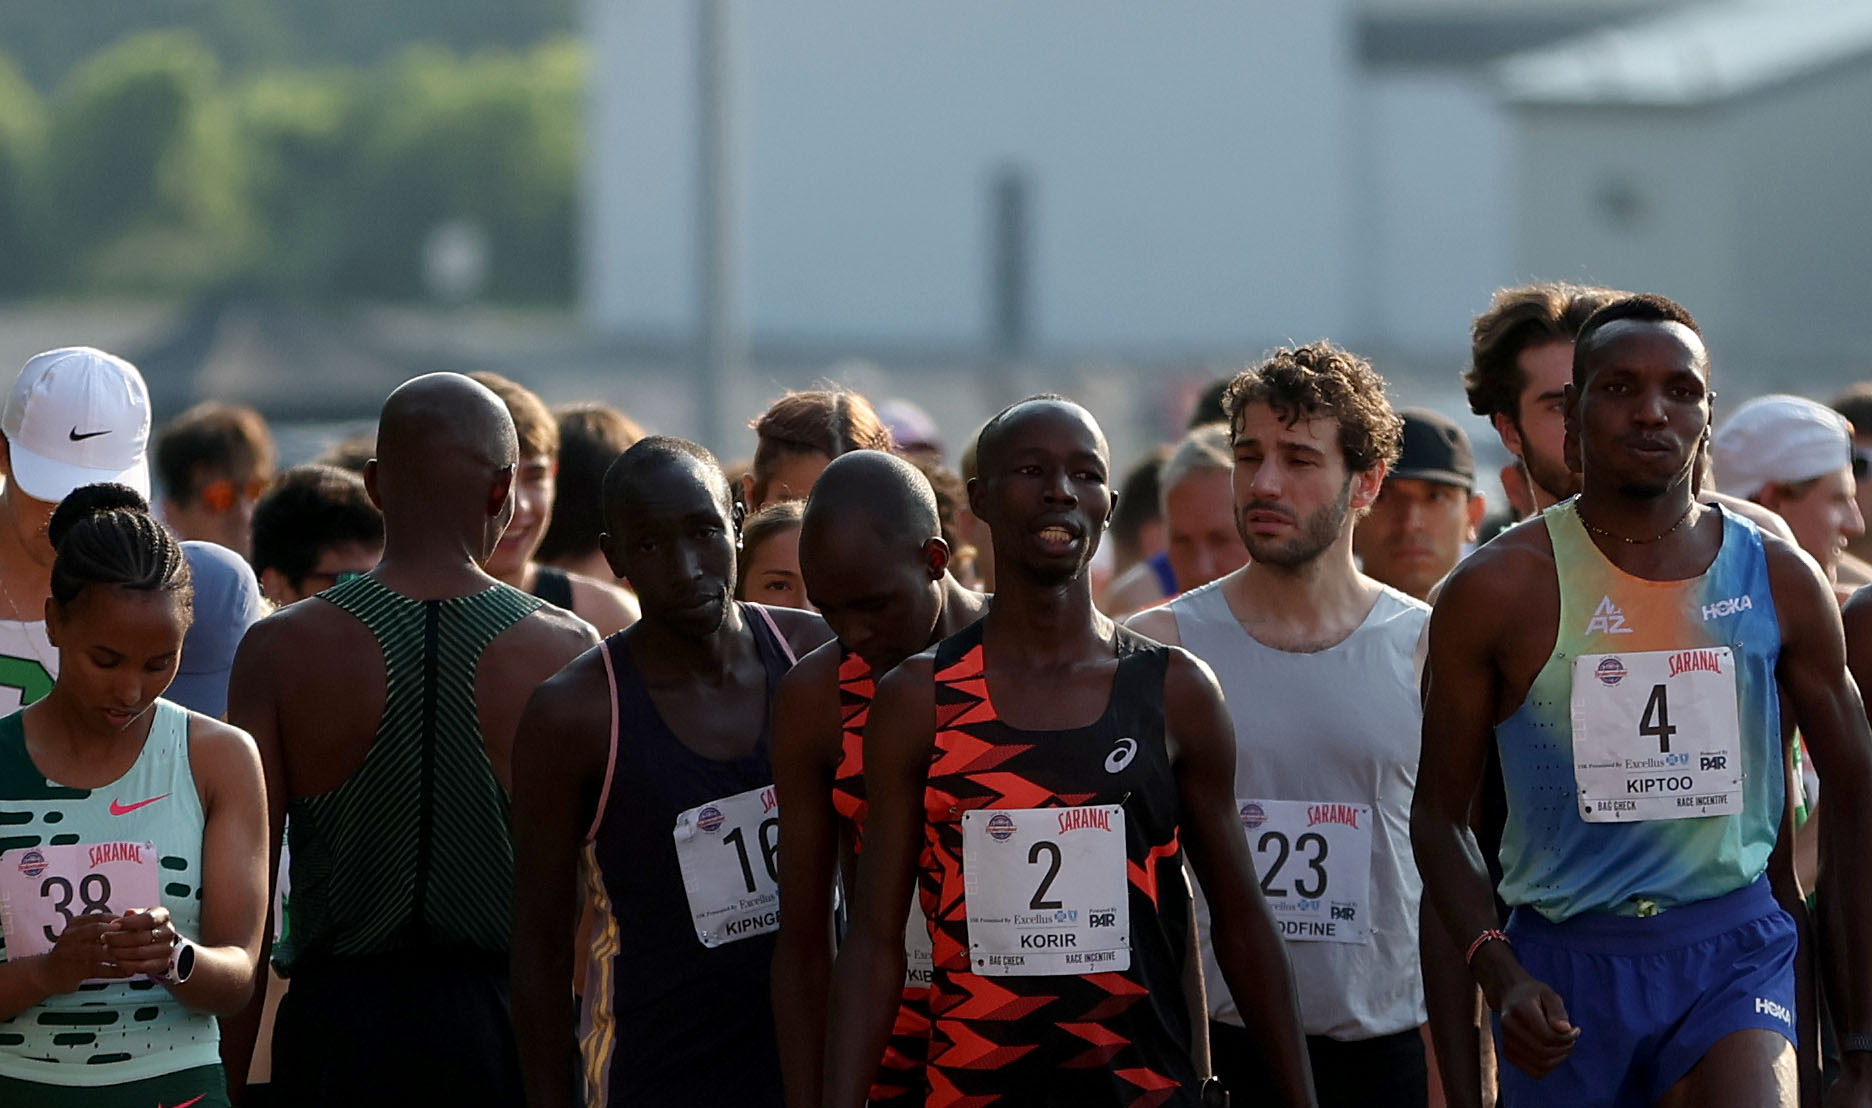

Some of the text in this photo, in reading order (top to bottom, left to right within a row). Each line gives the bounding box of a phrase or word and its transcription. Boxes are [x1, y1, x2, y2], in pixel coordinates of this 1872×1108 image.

[1702, 595, 1752, 621] HOKA
[1668, 650, 1722, 678] SARANAC
[1639, 684, 1677, 753] 4
[1625, 757, 1665, 770] Excellus
[1700, 756, 1727, 771] PAR
[1627, 776, 1693, 793] KIPTOO
[1598, 800, 1636, 811] BAG CHECK
[1058, 808, 1111, 835] SARANAC
[1307, 804, 1359, 830] SARANAC
[89, 843, 142, 869] SARANAC
[723, 817, 779, 893] 16
[1258, 831, 1328, 899] 23
[1028, 840, 1063, 910] 2
[40, 873, 113, 943] 38
[1331, 906, 1355, 921] PAR
[1014, 914, 1053, 925] Excellus
[1089, 913, 1116, 928] PAR
[1021, 933, 1077, 948] KORIR
[989, 955, 1025, 965] BAG CHECK
[1066, 951, 1116, 963] RACE INCENTIVE
